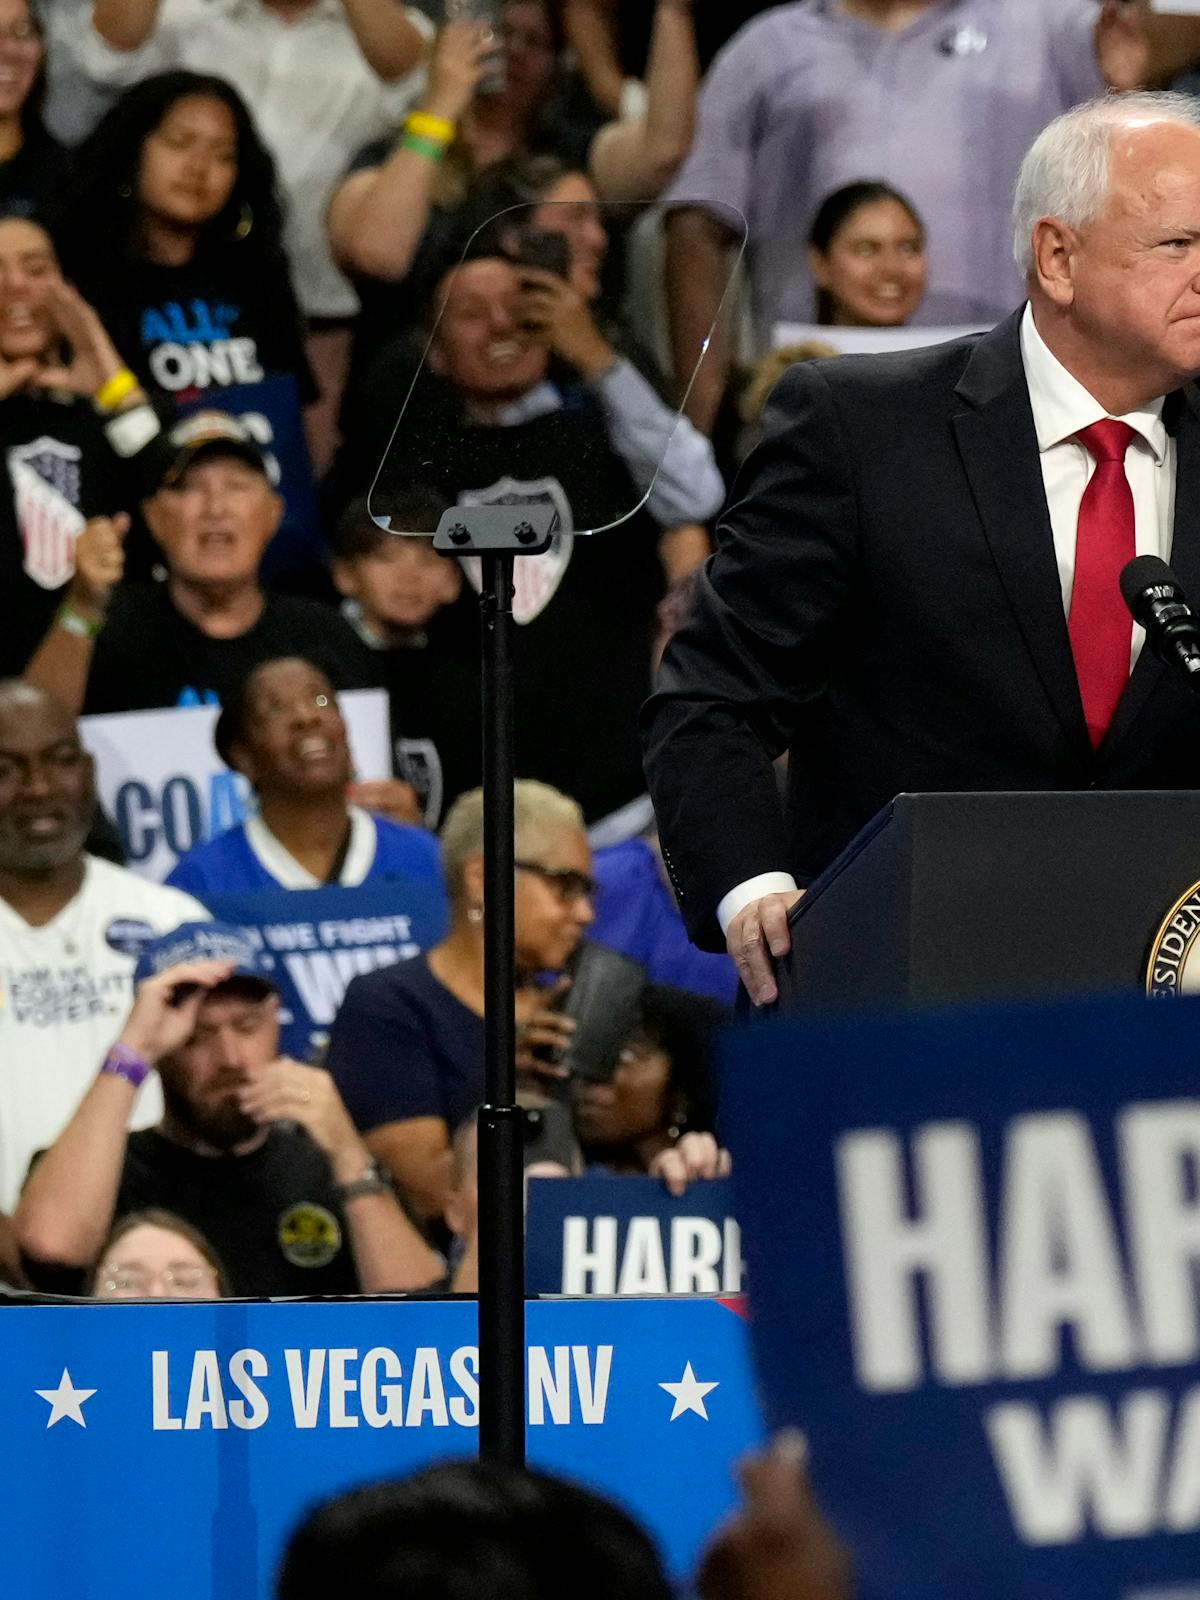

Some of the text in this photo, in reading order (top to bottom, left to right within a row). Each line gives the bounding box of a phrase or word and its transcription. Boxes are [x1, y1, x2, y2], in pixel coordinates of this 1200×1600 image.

[151, 337, 264, 390] ONE
[318, 915, 411, 948] FIGHT
[152, 1344, 614, 1431] LAS VEGAS NV
